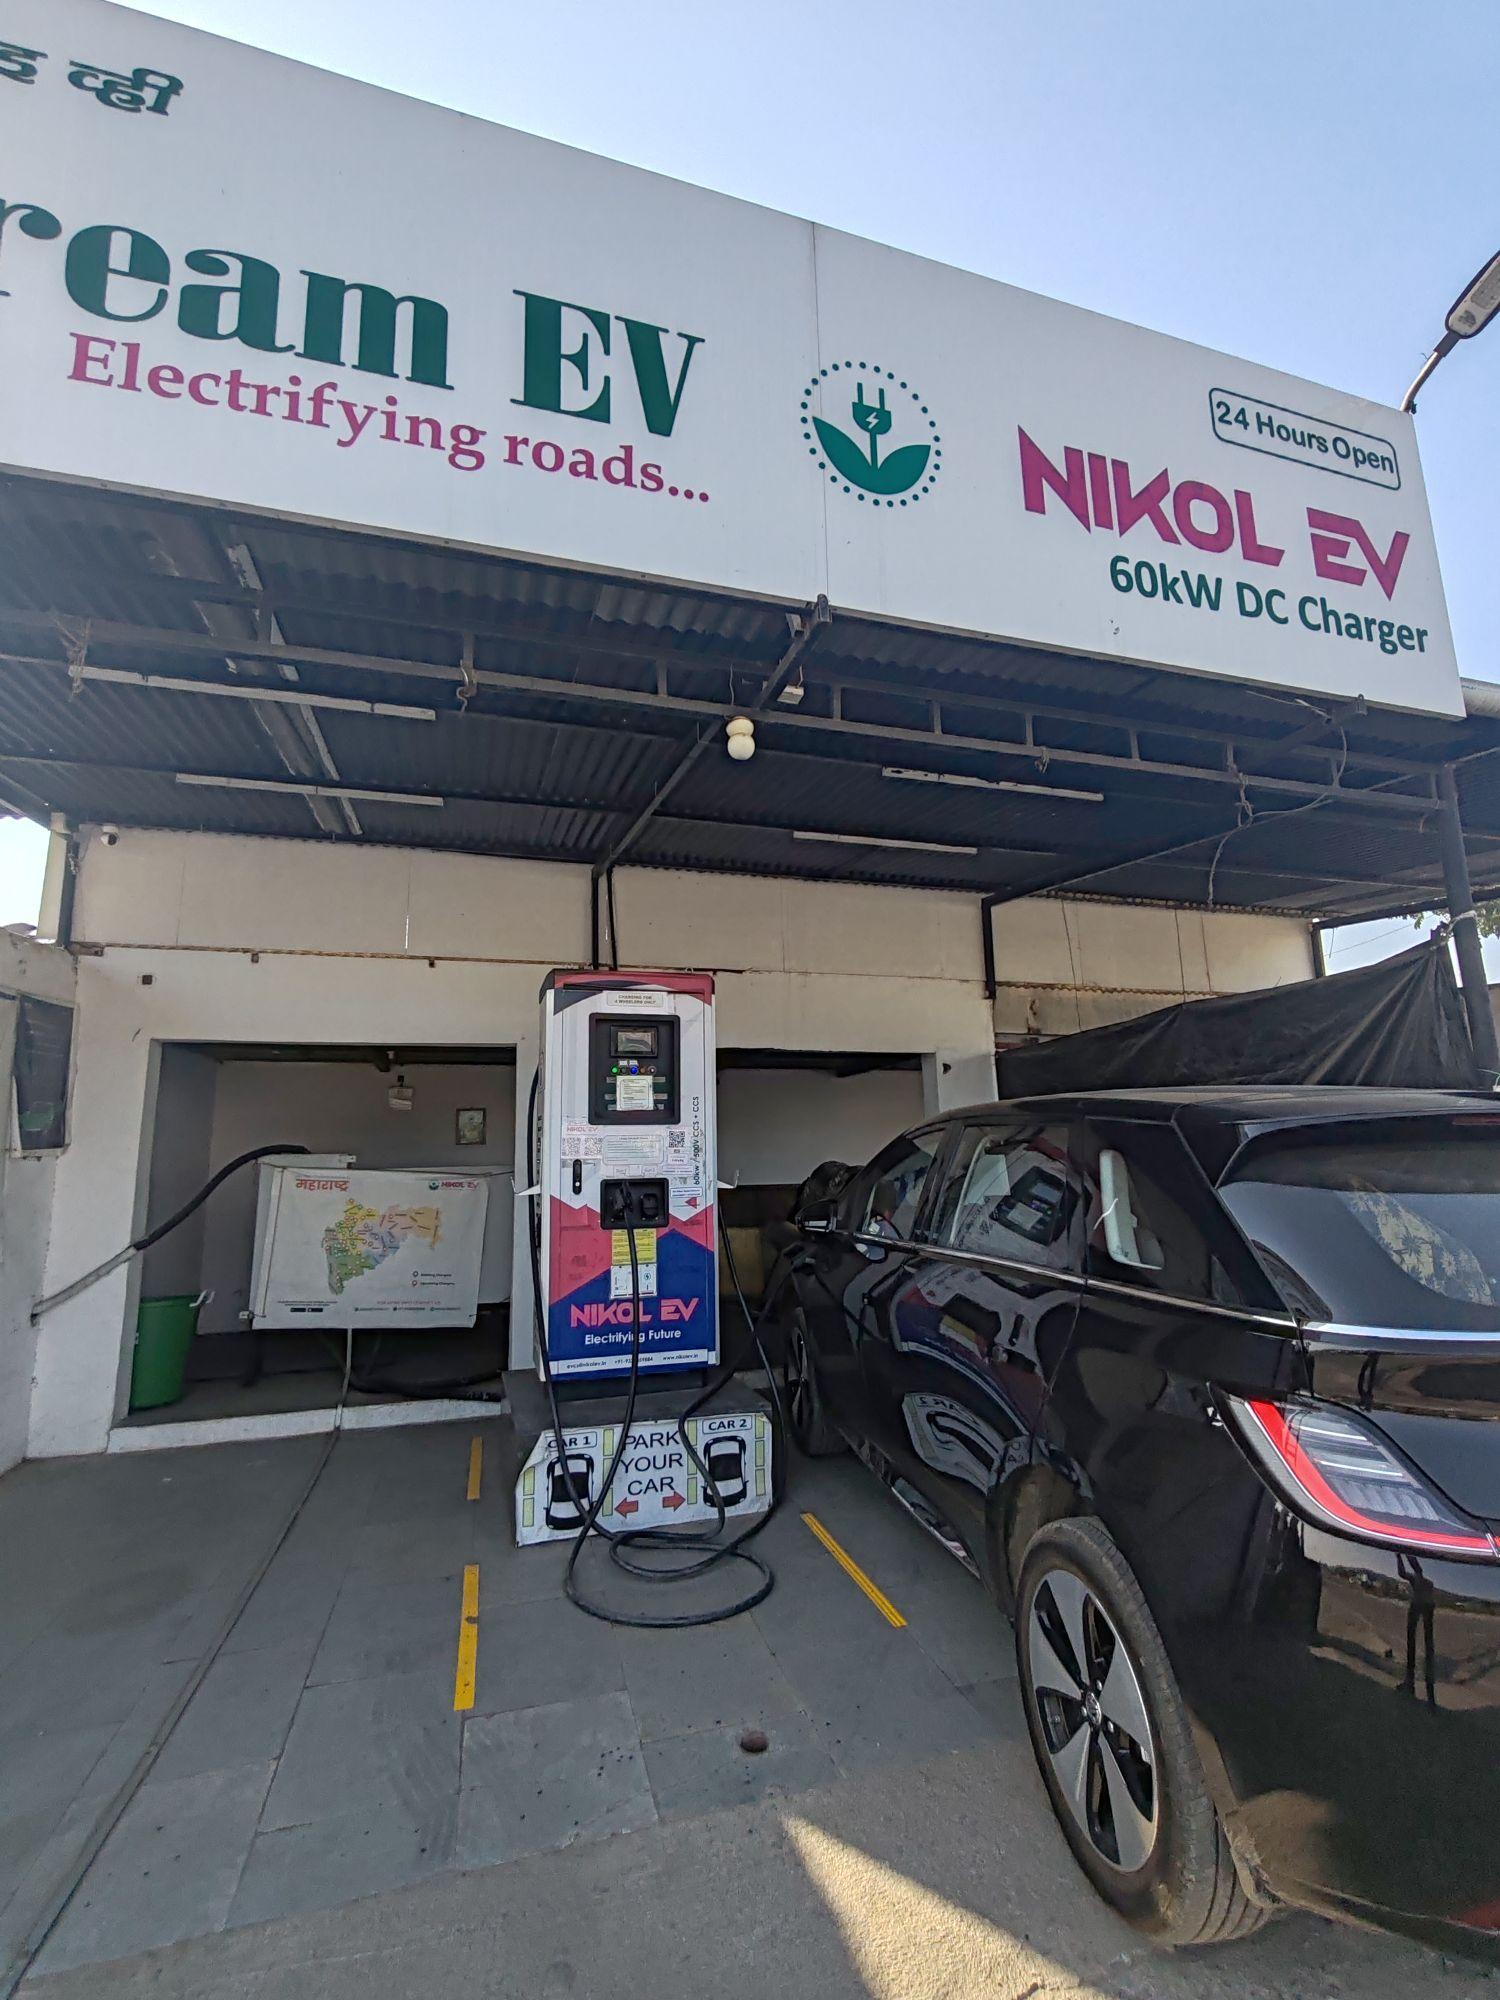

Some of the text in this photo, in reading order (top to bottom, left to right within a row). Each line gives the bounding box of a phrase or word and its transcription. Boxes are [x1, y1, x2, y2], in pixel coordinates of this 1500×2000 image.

[67, 59, 184, 117] व्ही
[511, 289, 705, 438] EV
[67, 332, 711, 503] Electrifying roads...
[1217, 400, 1395, 475] 24 Hours Open
[1018, 425, 1410, 600] NIKOL EV
[1110, 555, 1428, 655] 60kW DC Charger
[296, 1178, 351, 1191] महाराष्ट्र
[441, 1181, 479, 1191] NIKOL EV
[571, 1298, 699, 1327] NIKOL EV
[585, 1329, 681, 1345] Electrifyig Future
[708, 1418, 747, 1431] CAR 2
[583, 1436, 590, 1445] 1
[622, 1430, 681, 1451] PARK
[620, 1453, 683, 1474] YOUR
[627, 1476, 675, 1496] CAR
